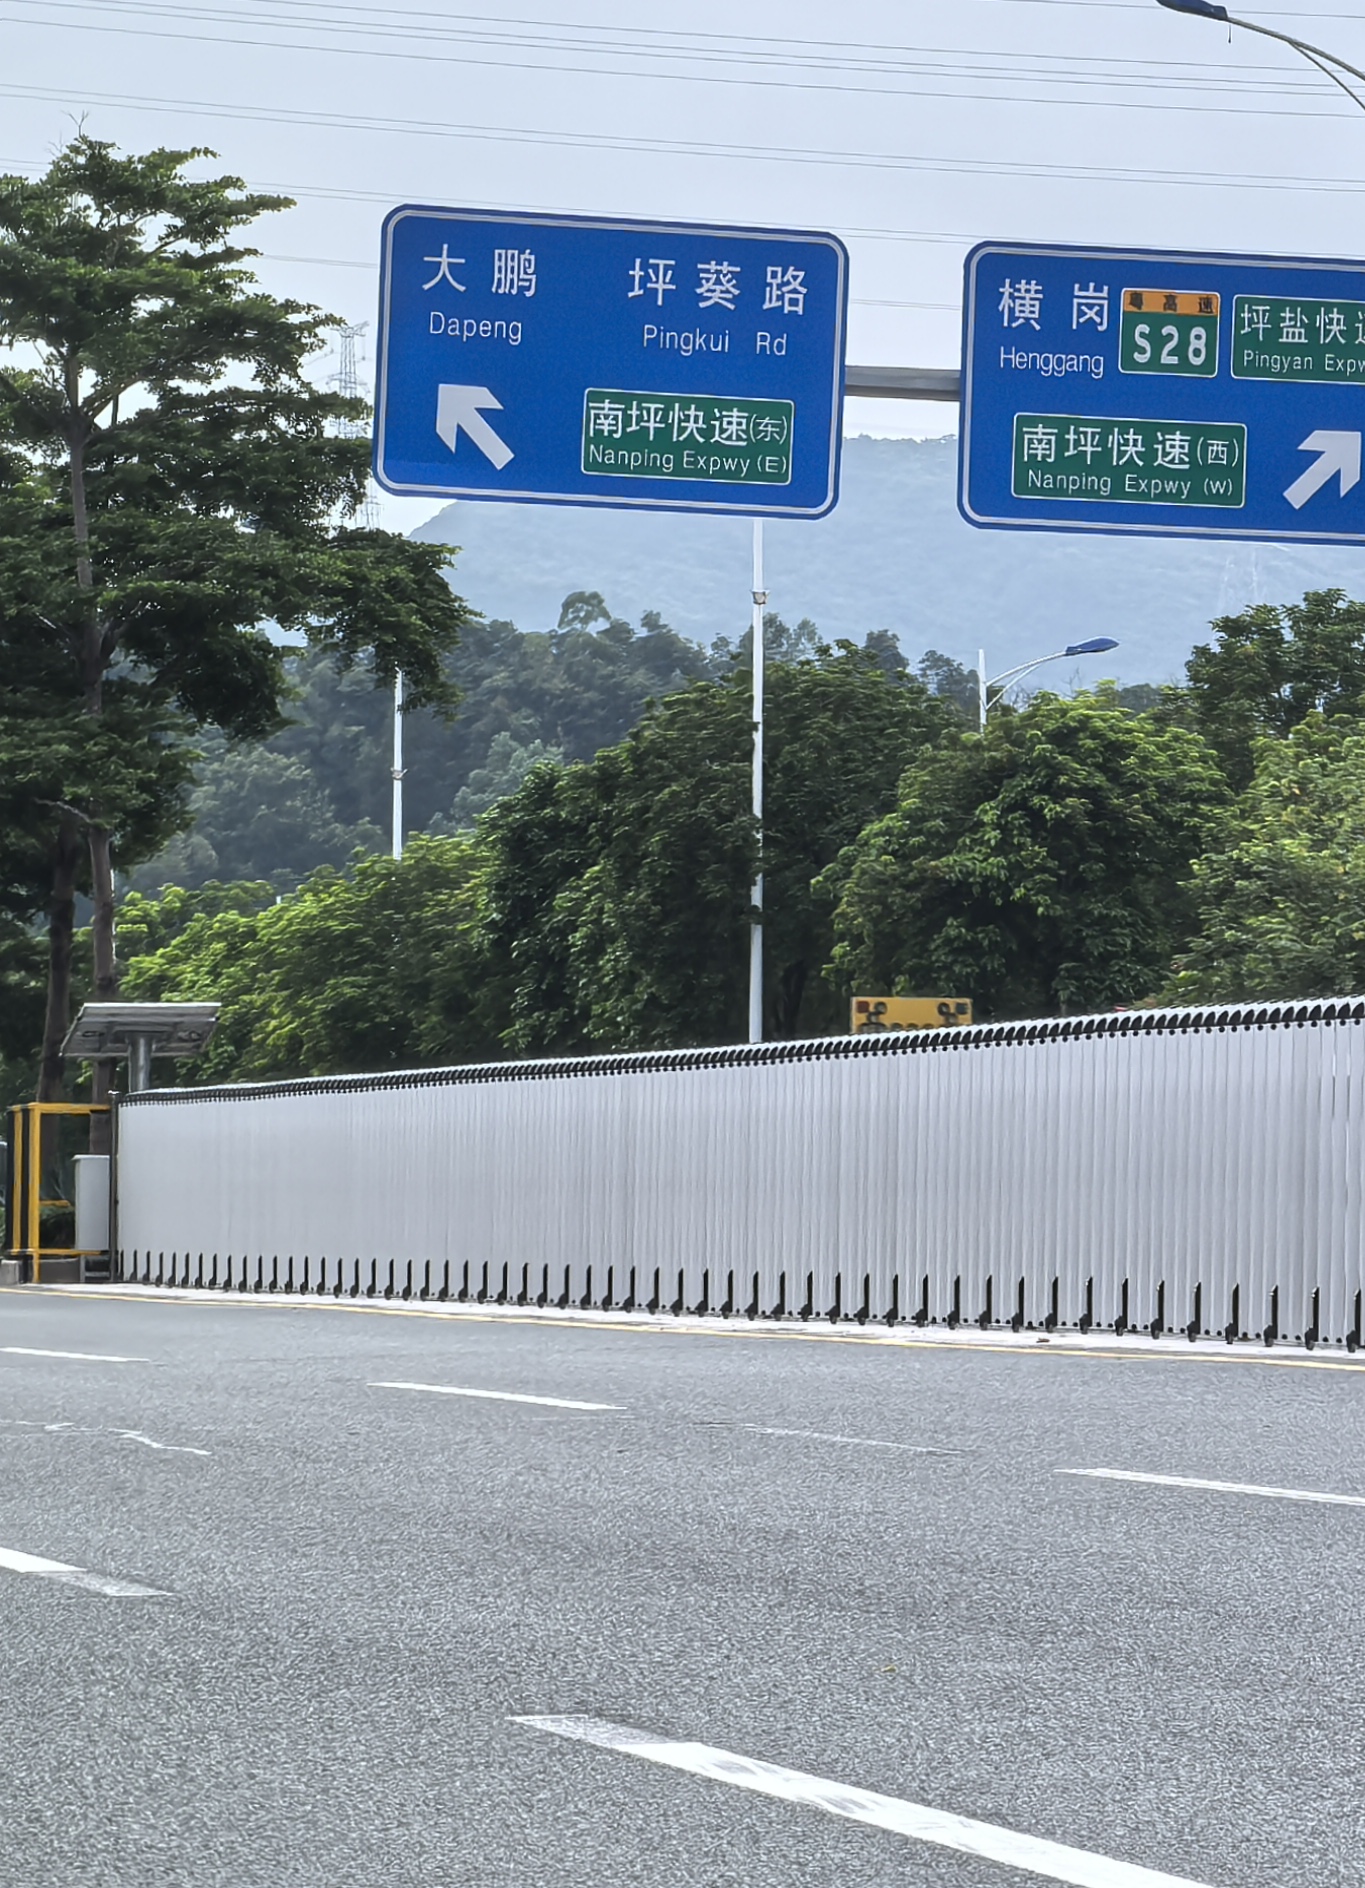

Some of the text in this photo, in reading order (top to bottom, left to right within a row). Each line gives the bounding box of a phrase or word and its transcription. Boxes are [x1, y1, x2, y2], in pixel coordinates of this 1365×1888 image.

[422, 243, 537, 298] 大鹏
[628, 257, 808, 316] 坪葵路
[998, 277, 1109, 333] 横岗
[429, 311, 523, 346] Dapeng
[643, 324, 787, 357] Pingkui Rd
[1133, 323, 1206, 366] S28
[1000, 346, 1105, 380] Henggang
[1243, 349, 1313, 373] Pingyan
[589, 444, 786, 477] Nanping Expwy (E)
[1027, 469, 1112, 496] Nanping
[1125, 474, 1191, 499] Expwy
